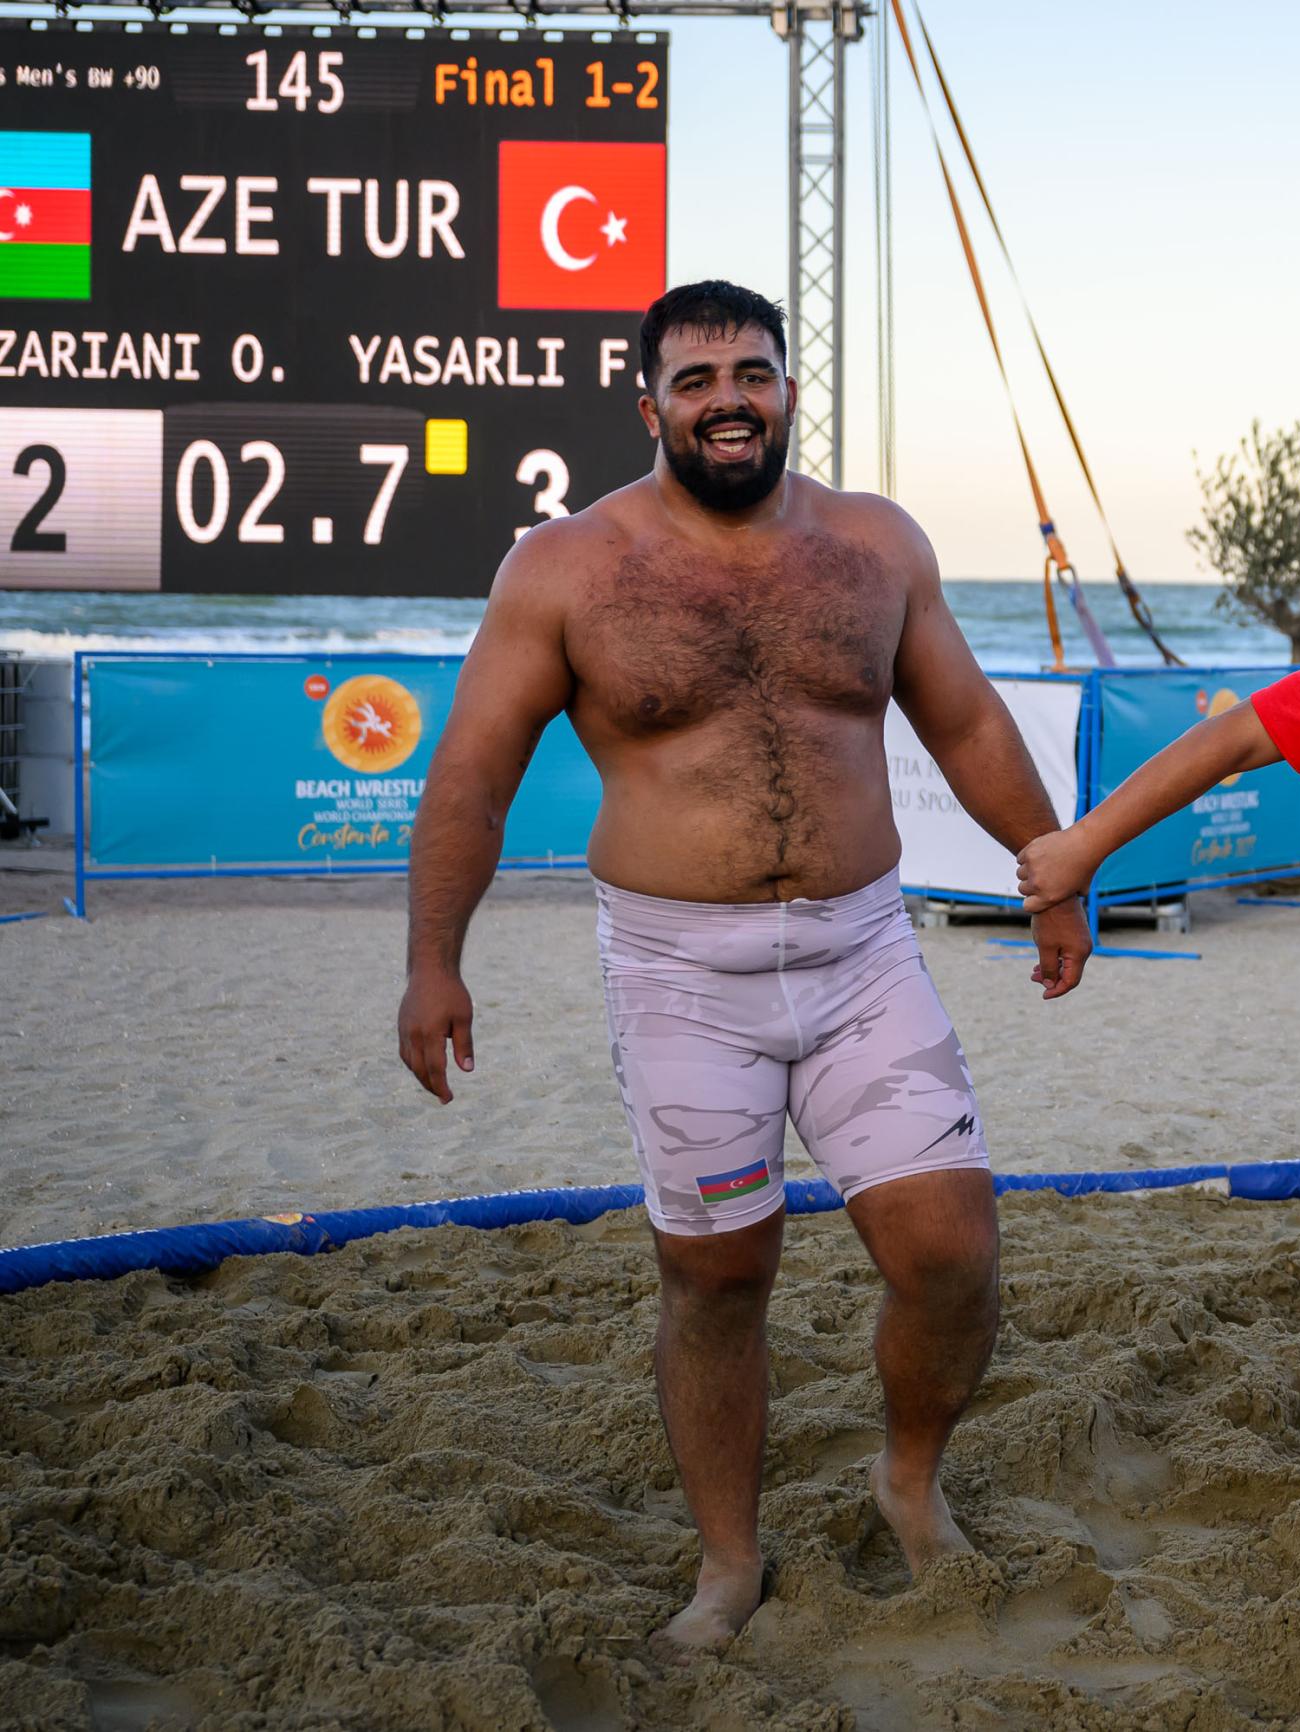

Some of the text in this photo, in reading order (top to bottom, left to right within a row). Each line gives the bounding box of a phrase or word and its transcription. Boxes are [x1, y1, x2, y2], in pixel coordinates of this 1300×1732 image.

[16, 62, 78, 88] Men's
[88, 66, 113, 88] BW
[123, 65, 160, 90] +90
[245, 50, 345, 113] 145
[435, 57, 659, 108] Final 1-2
[121, 174, 466, 259] AZE TUR
[0, 329, 200, 381] ZARIANI
[348, 335, 565, 387] YASARLI
[11, 445, 67, 553] 2
[176, 440, 410, 546] 02.7
[514, 448, 570, 541] 3
[295, 779, 350, 799] BEACH
[336, 799, 409, 810] WORLD SERIES
[298, 823, 389, 850] Constanta
[314, 810, 350, 822] WORLD
